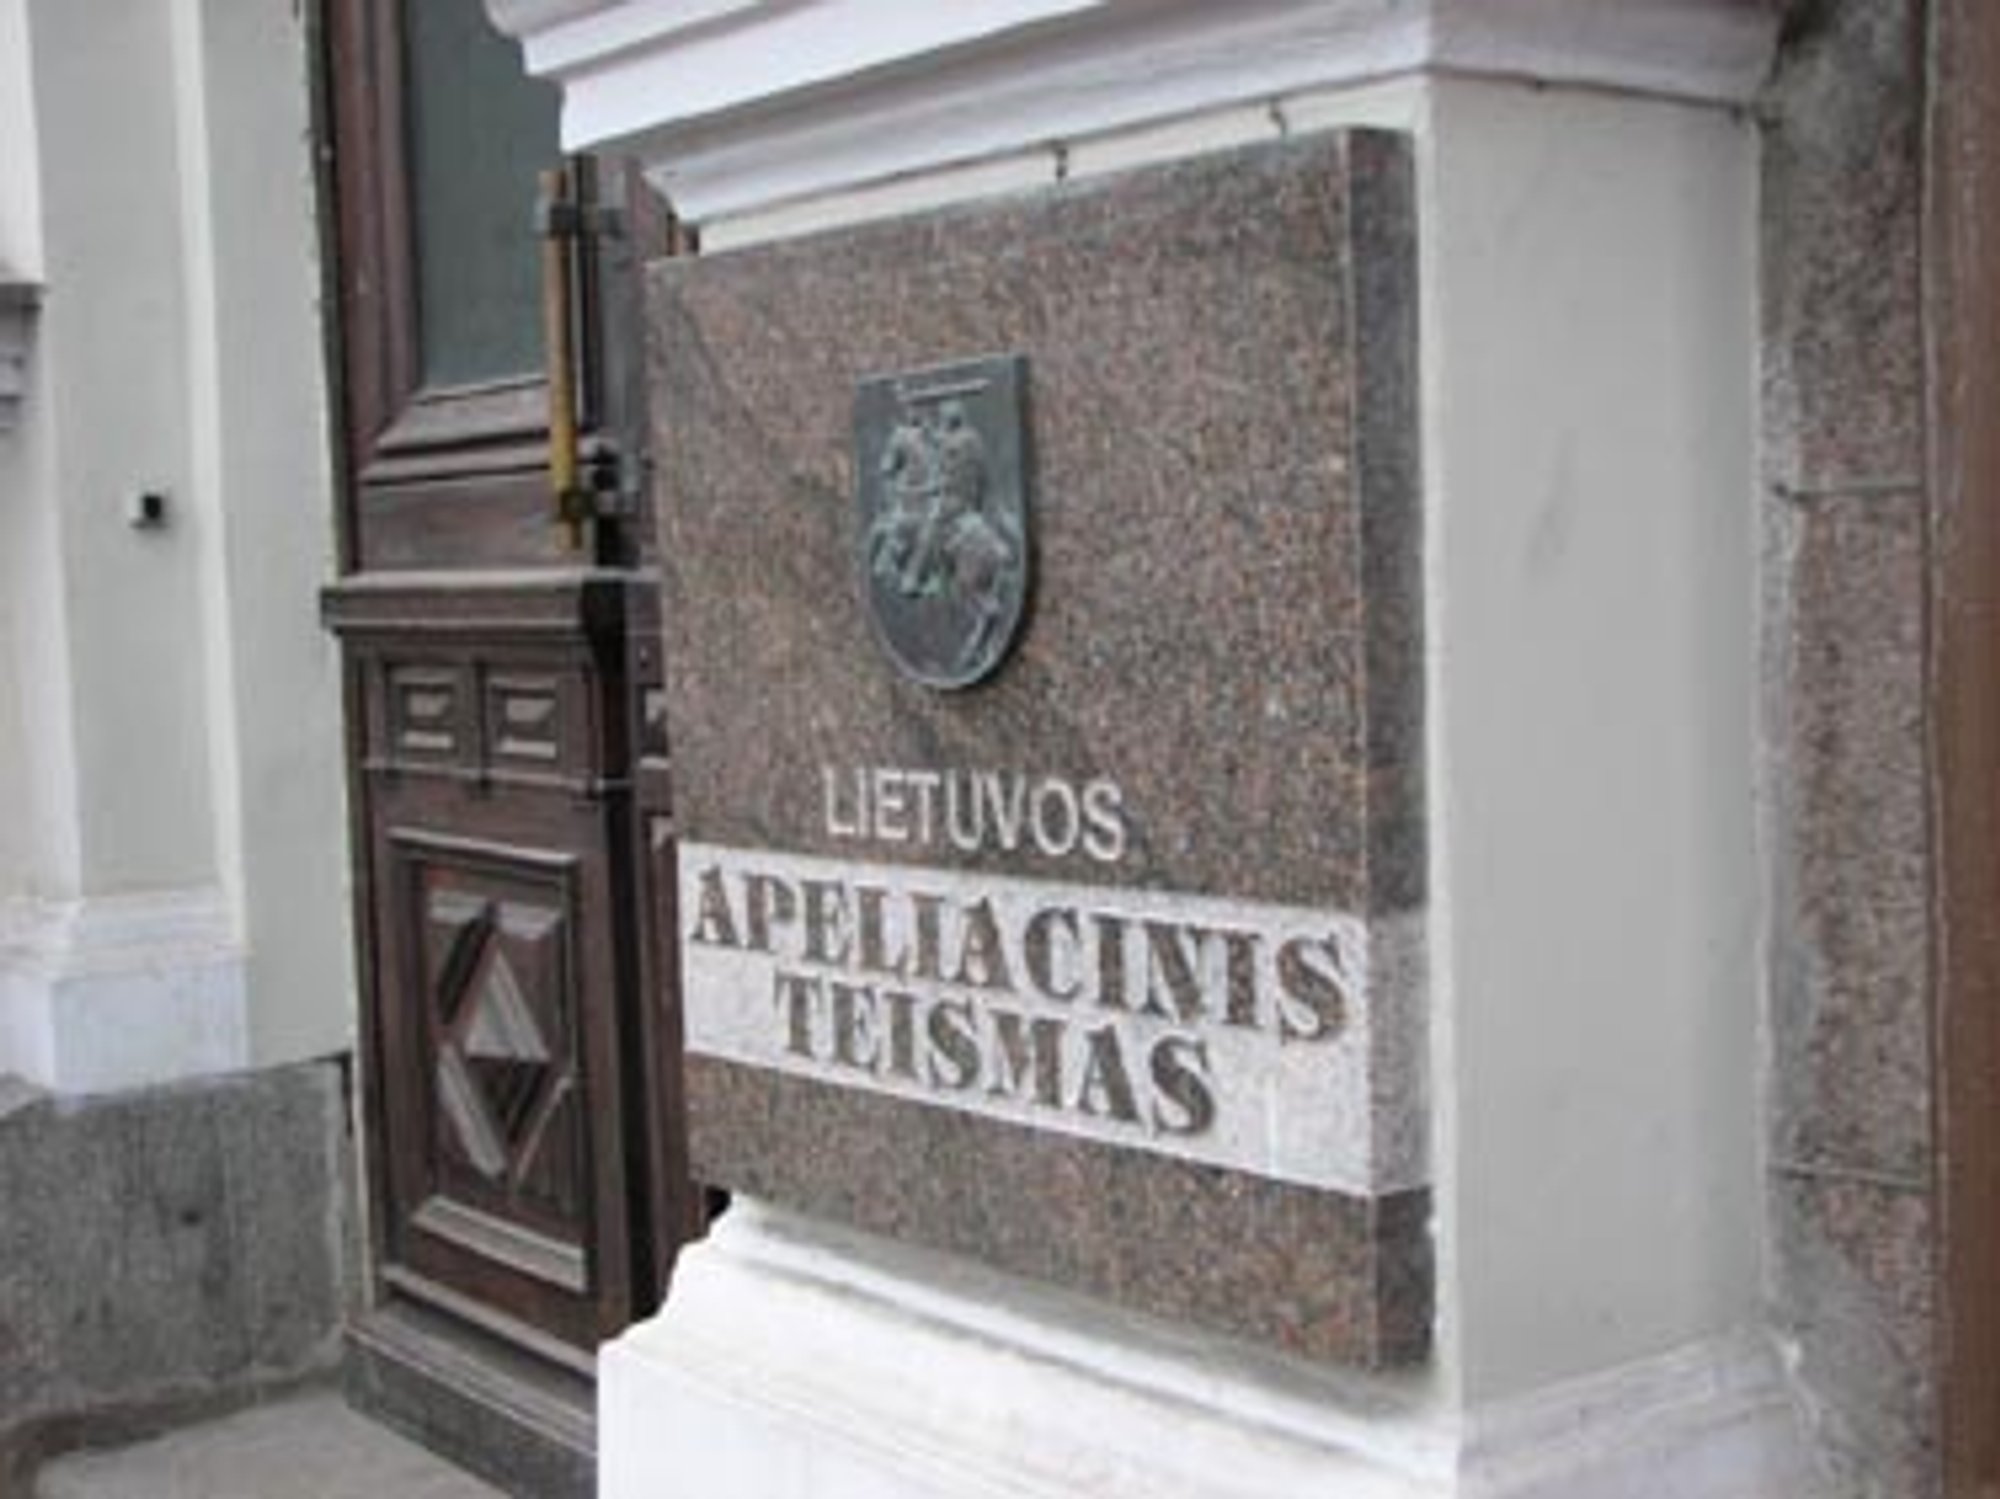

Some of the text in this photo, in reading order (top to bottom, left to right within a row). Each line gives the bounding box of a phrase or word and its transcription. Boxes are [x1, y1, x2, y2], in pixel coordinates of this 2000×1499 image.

[824, 767, 1125, 860] LIETUVOS
[691, 865, 1347, 1042] APELIACINIS
[775, 971, 1214, 1136] TEISMAS
